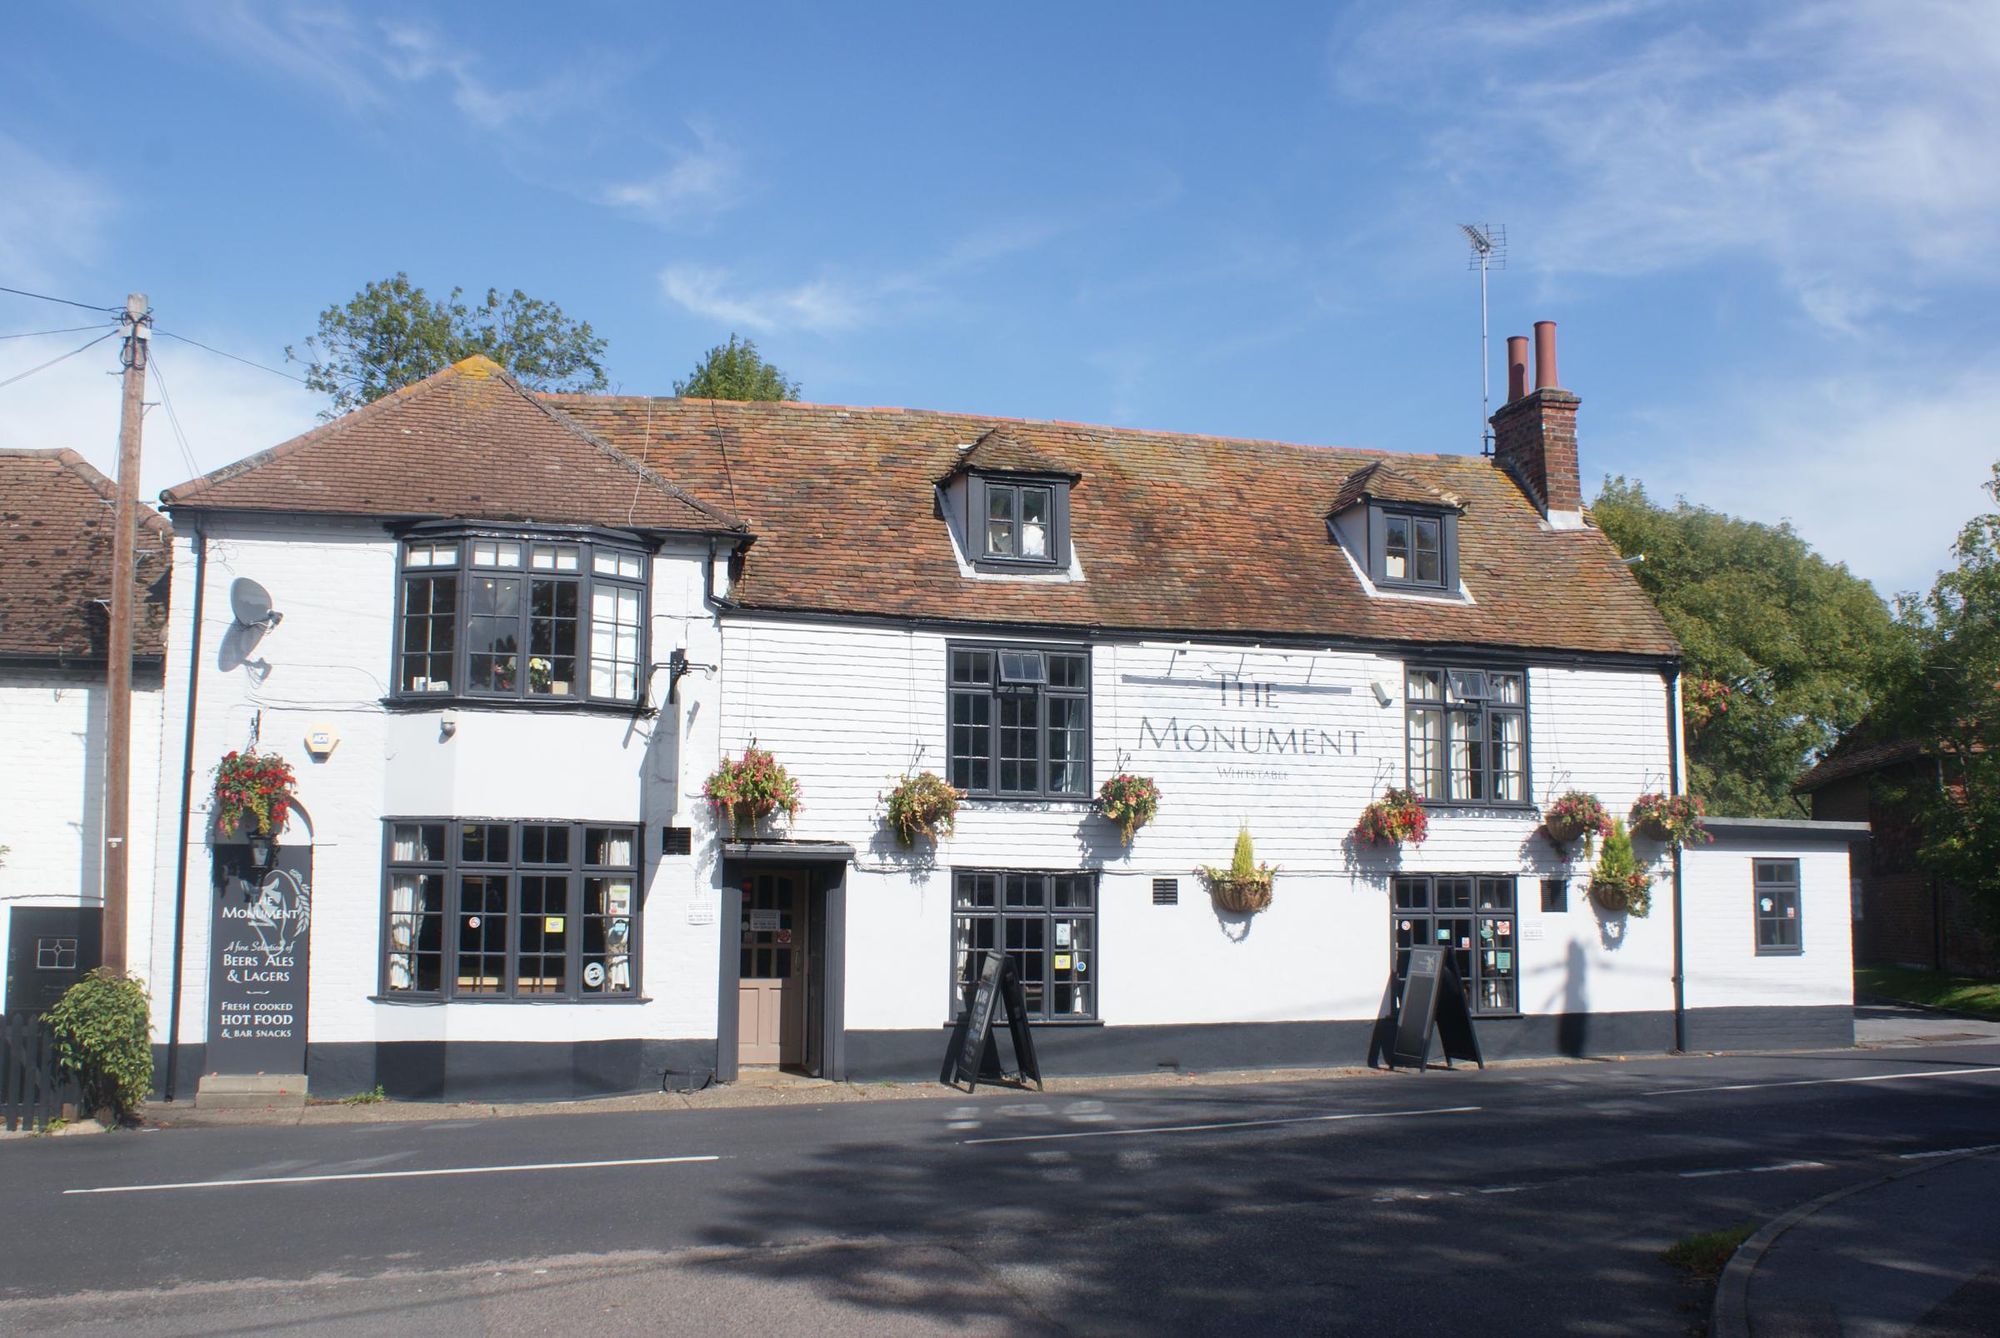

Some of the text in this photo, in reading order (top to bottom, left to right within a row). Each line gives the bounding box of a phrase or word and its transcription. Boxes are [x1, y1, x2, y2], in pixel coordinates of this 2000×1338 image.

[1218, 673, 1279, 708] THE
[1138, 716, 1366, 756] MONUMENT
[1216, 765, 1289, 781] WHITSTABLE
[222, 907, 299, 919] MONUMENT
[286, 941, 296, 953] of
[223, 954, 295, 967] BEERS ALES
[227, 969, 290, 983] & LAGERS
[221, 1001, 293, 1011] FRESH COOKED
[221, 1014, 294, 1025] HOT FOOD
[221, 1028, 292, 1038] & BAR SNACKS
